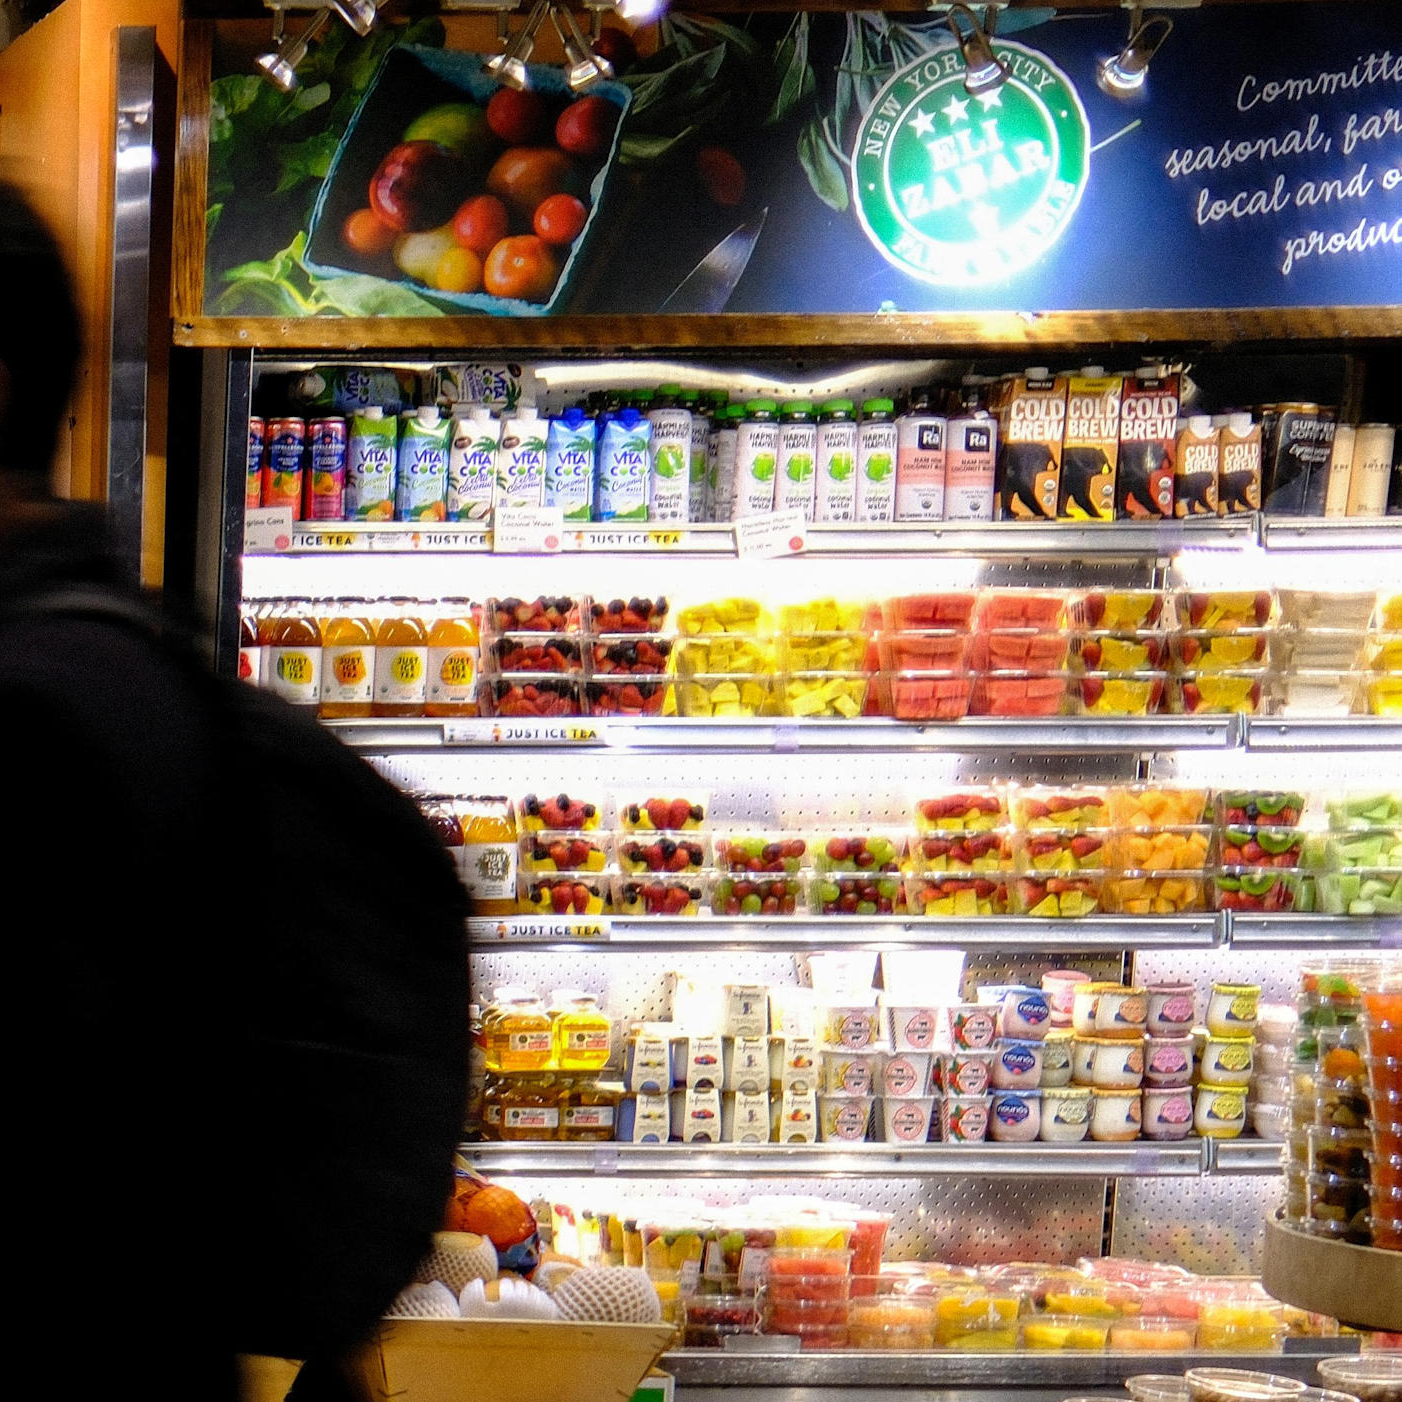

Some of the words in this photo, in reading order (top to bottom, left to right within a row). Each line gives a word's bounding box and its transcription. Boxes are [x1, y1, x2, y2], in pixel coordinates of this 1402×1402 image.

[864, 93, 902, 158] NEW
[904, 52, 966, 92] YOR
[927, 119, 1004, 172] ELI
[1165, 114, 1332, 178] seasonal,
[1198, 174, 1290, 225] local
[1296, 163, 1374, 206] and
[1012, 400, 1065, 420] COLD
[1069, 400, 1119, 419] COLD
[1121, 398, 1177, 419] COLD
[1009, 420, 1064, 441] BREW
[1067, 419, 1118, 438] BREW
[1120, 419, 1176, 440] BREW
[923, 433, 940, 445] Ra
[970, 433, 986, 446] Ra
[361, 450, 388, 462] VITA
[1185, 446, 1218, 460] COLD
[1225, 443, 1258, 458] COLD
[414, 451, 442, 463] VITA
[463, 452, 491, 464] VITA
[512, 452, 540, 464] VITA
[558, 453, 586, 465] VITA
[614, 453, 642, 465] VITA
[1185, 459, 1218, 474] BREW
[1224, 458, 1258, 473] BREW
[301, 535, 323, 545] ICE
[328, 535, 353, 545] TEA
[427, 535, 461, 545] JUST
[465, 535, 486, 545] ICE
[590, 535, 622, 544] JUST
[628, 535, 649, 544] ICE
[655, 535, 679, 544] TEA
[286, 657, 307, 665] JUST
[339, 657, 361, 665] JUST
[398, 656, 419, 664] JUST
[449, 656, 470, 664] JUST
[506, 728, 539, 739] JUST
[545, 728, 566, 738] ICE
[571, 728, 597, 738] TEA
[511, 925, 544, 936] JUST
[550, 925, 571, 936] ICE
[576, 926, 601, 935] TEA
